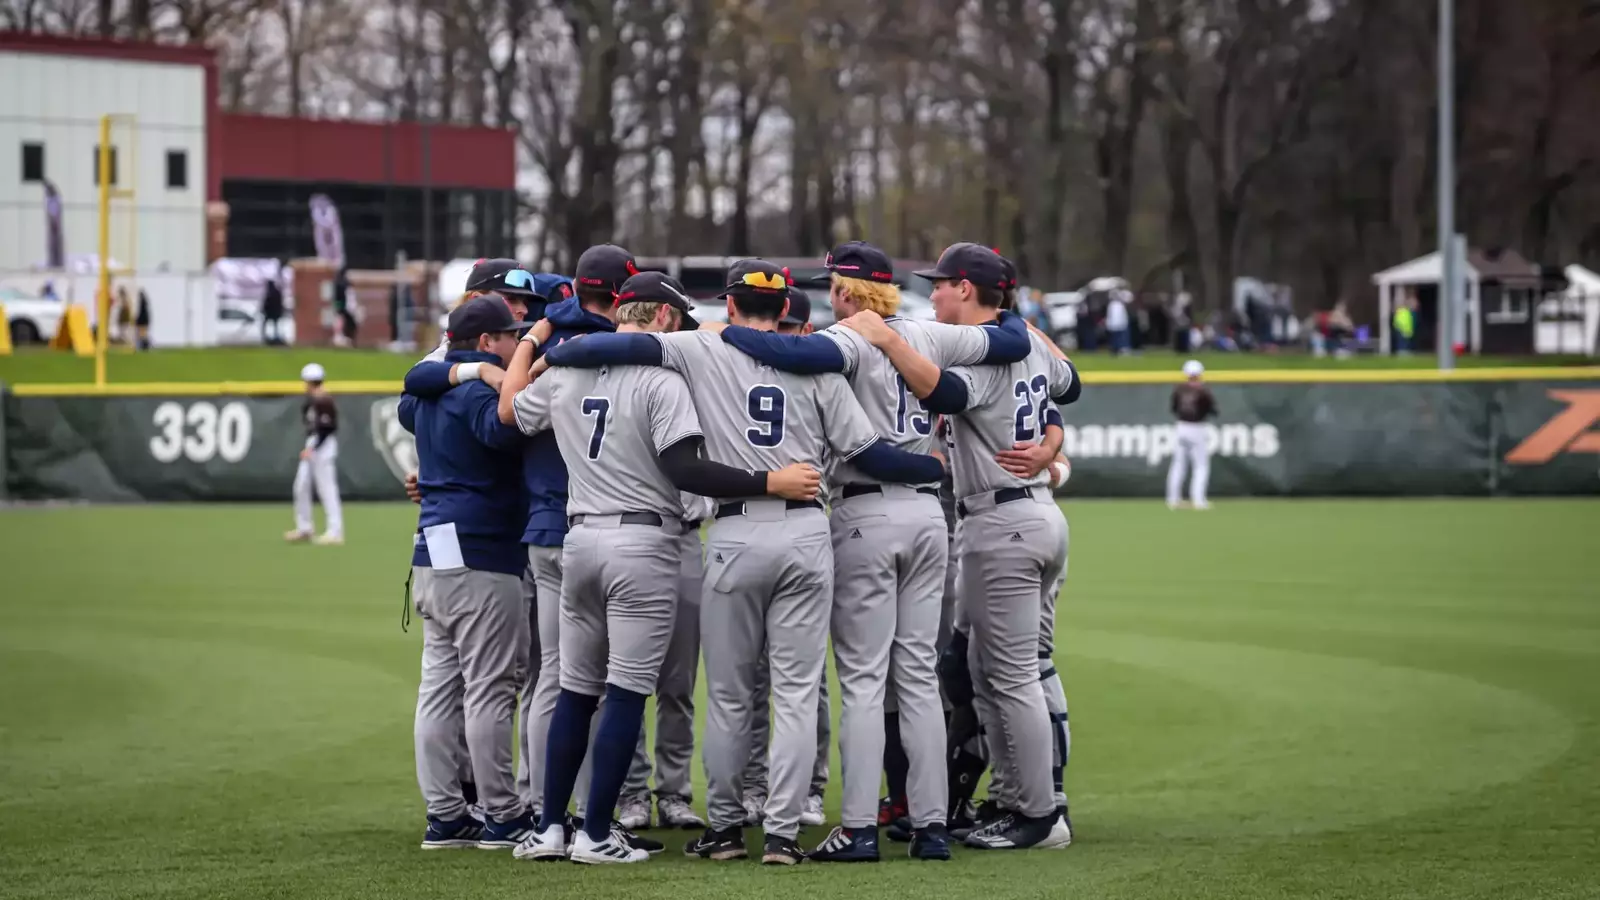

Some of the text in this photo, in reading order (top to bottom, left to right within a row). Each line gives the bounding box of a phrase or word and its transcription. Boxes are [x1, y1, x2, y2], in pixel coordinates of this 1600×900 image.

[150, 401, 252, 463] 330
[581, 396, 610, 461] 7
[745, 384, 786, 448] 9
[1013, 372, 1050, 442] 22
